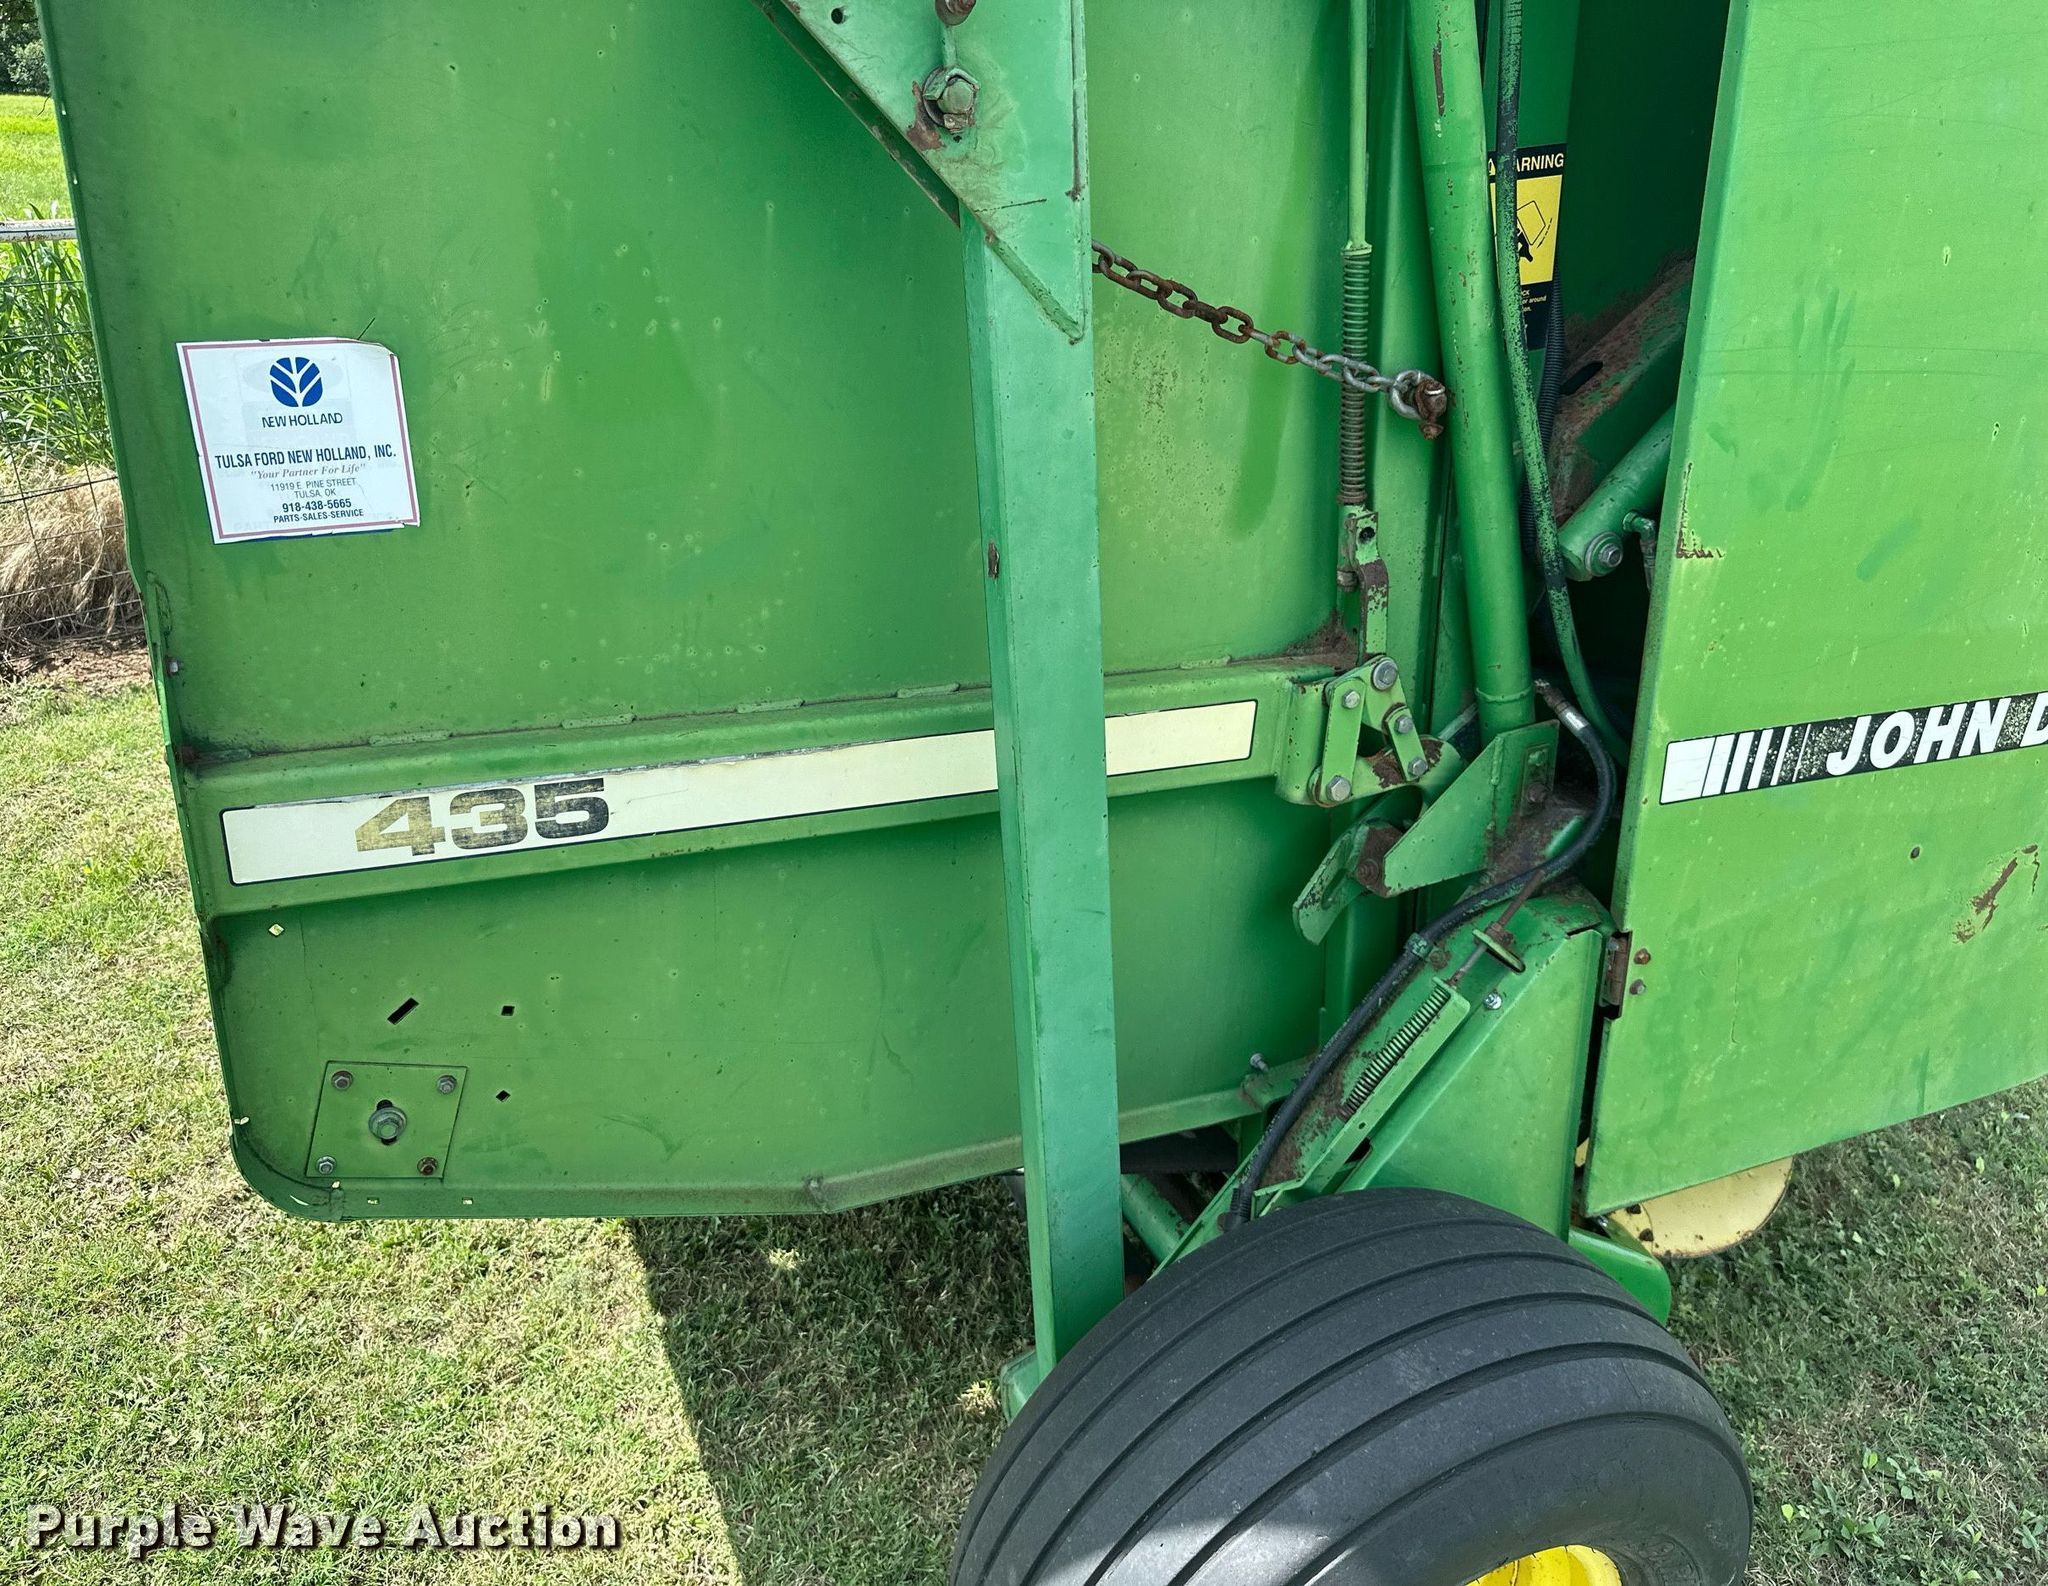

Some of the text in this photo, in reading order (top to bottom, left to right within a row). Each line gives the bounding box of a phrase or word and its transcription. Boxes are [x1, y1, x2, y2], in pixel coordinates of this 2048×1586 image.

[262, 412, 343, 428] NEW HOLLAND
[214, 443, 397, 469] TULSA FORD NEW HOLLAND, INC.
[282, 468, 319, 478] Partner
[321, 465, 340, 475] For
[270, 482, 295, 492] 11919
[305, 480, 324, 489] PINE
[326, 477, 356, 488] STREET
[324, 488, 337, 497] OK
[282, 498, 352, 513] 918-438-5665
[273, 508, 364, 524] PARTS-SALES-SERVICE
[1825, 697, 2011, 777] JOHN
[354, 777, 610, 857] 435
